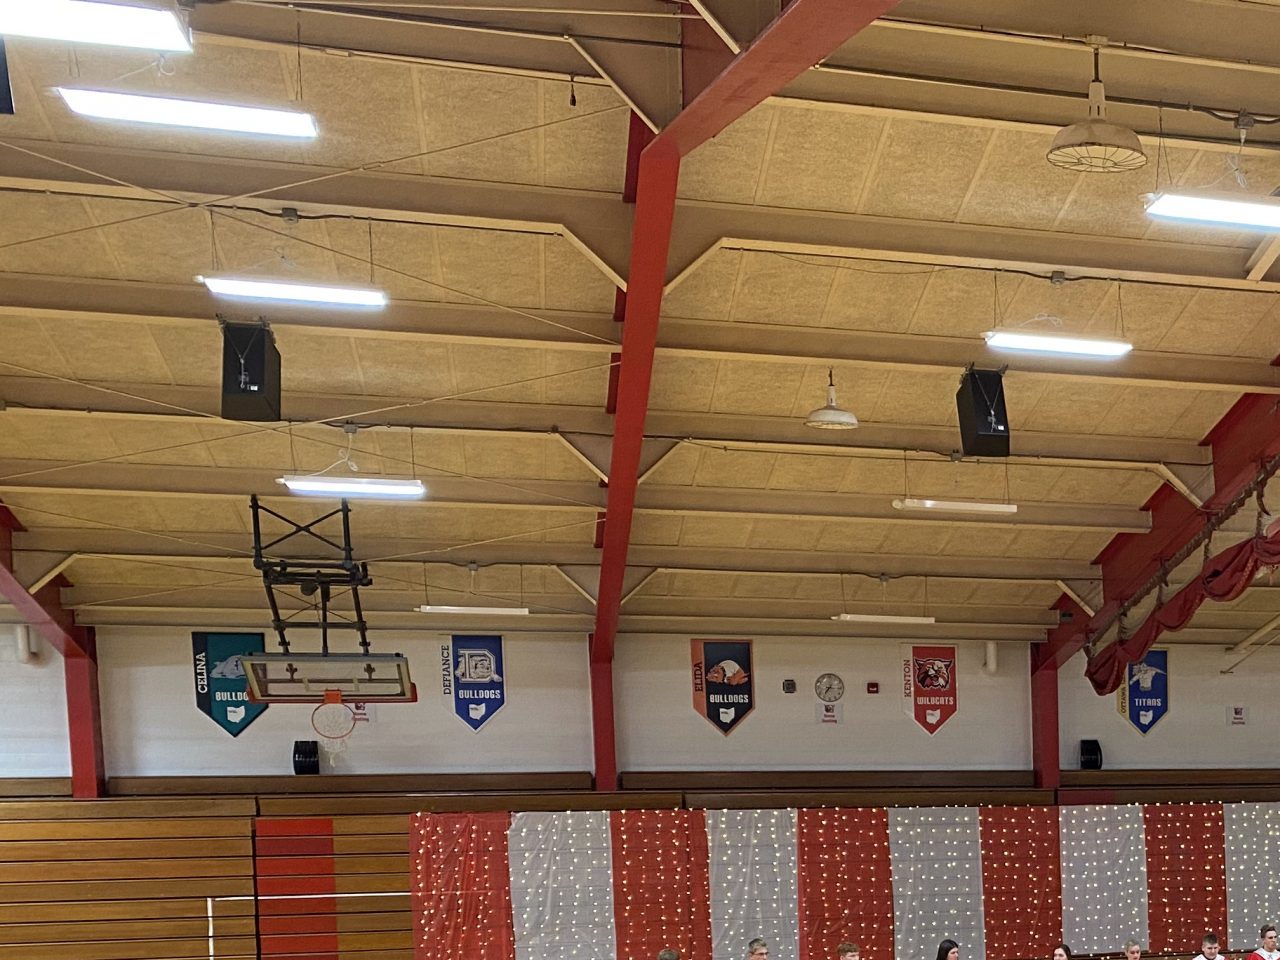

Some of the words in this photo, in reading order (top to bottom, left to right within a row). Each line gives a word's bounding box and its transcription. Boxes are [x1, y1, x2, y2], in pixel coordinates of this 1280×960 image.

[196, 652, 208, 694] CELINA
[441, 645, 452, 695] DEFIANCE
[694, 661, 704, 692] ELIDA
[904, 659, 912, 698] KENTON
[215, 692, 249, 701] BULLDO
[458, 690, 501, 699] BULLDOGS
[709, 694, 749, 703] BULLDOGS
[1134, 698, 1162, 707] TITANS
